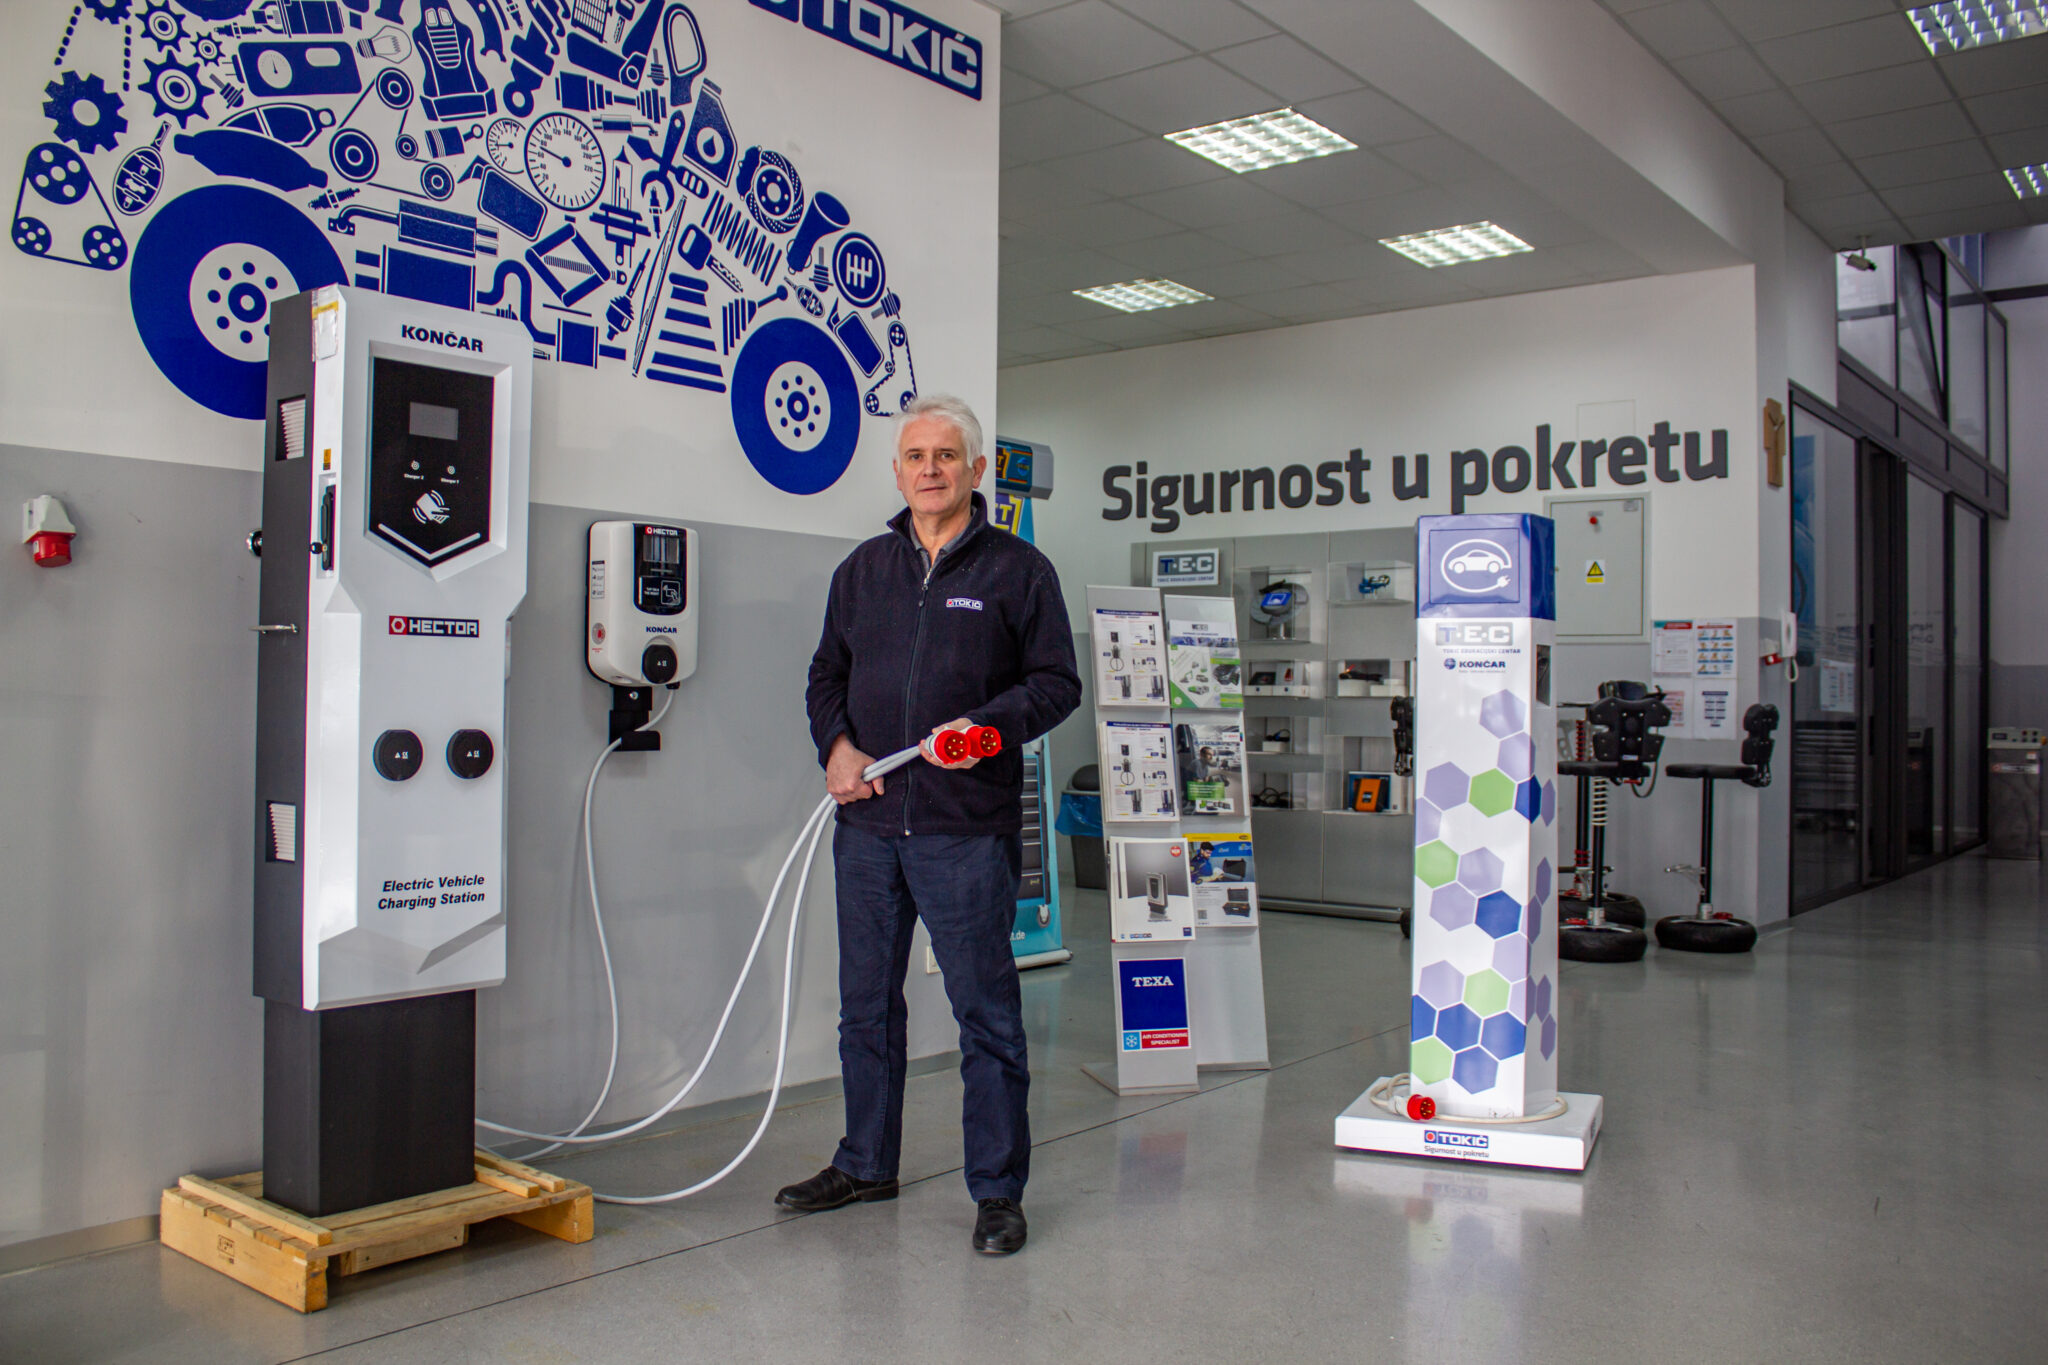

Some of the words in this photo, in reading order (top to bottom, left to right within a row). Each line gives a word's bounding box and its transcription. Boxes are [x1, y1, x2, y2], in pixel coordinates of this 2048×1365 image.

[401, 324, 484, 353] KONČAR
[1102, 448, 1371, 533] Sigurnost
[1392, 454, 1429, 500] u
[1451, 421, 1728, 513] pokretu
[653, 527, 678, 536] HECTOR
[409, 619, 478, 635] HECTOR
[646, 626, 677, 634] KONČAR
[382, 878, 434, 892] Electric
[439, 874, 485, 888] Vehicle
[378, 895, 436, 910] Charging
[440, 892, 485, 905] Station
[1132, 976, 1174, 987] TEXA
[1439, 1133, 1488, 1148] TOKIĆ
[1424, 1145, 1455, 1154] Sigurnost
[1463, 1149, 1489, 1158] pokretu
